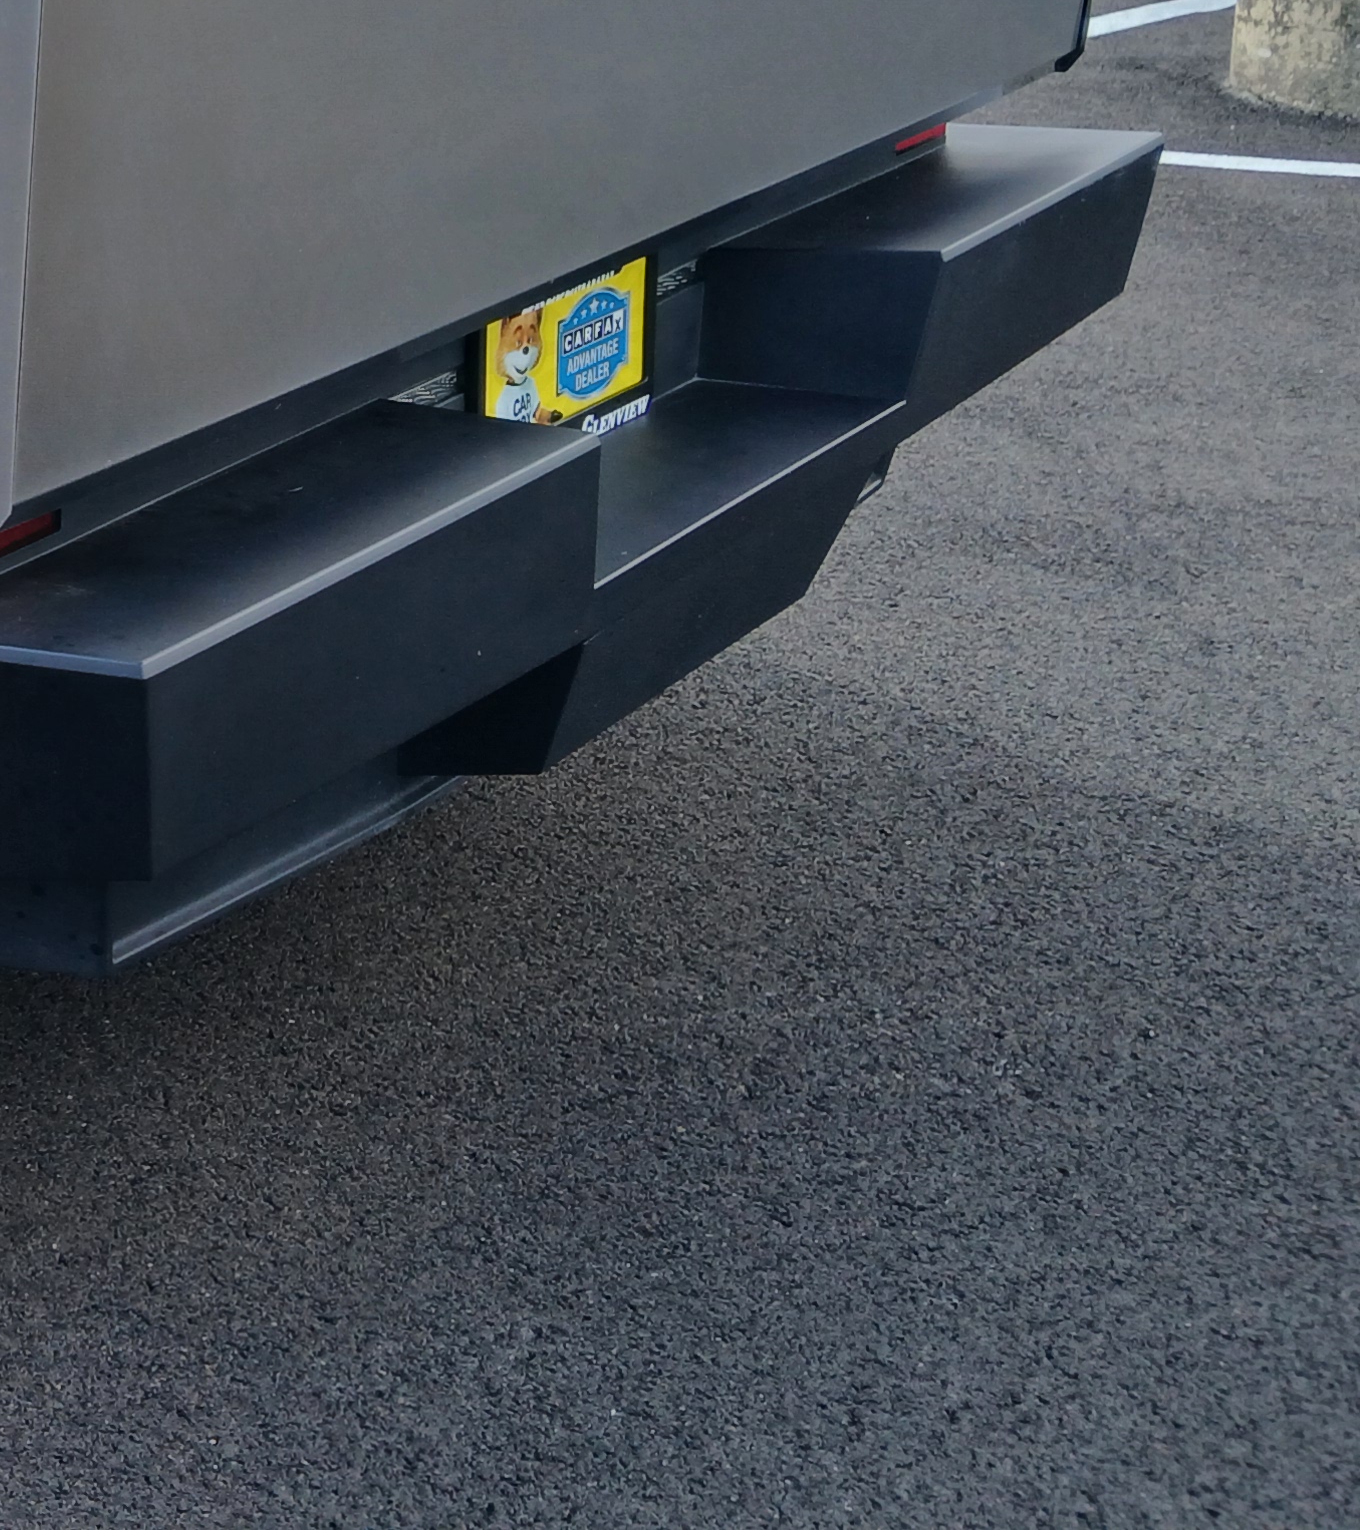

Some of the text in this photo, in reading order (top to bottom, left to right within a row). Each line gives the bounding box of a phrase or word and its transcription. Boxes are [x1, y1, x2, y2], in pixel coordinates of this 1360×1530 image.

[564, 311, 623, 353] CARFAX
[566, 337, 619, 377] ADVANTAGE
[575, 361, 610, 392] DEALER
[581, 393, 651, 436] GLENVIEW
